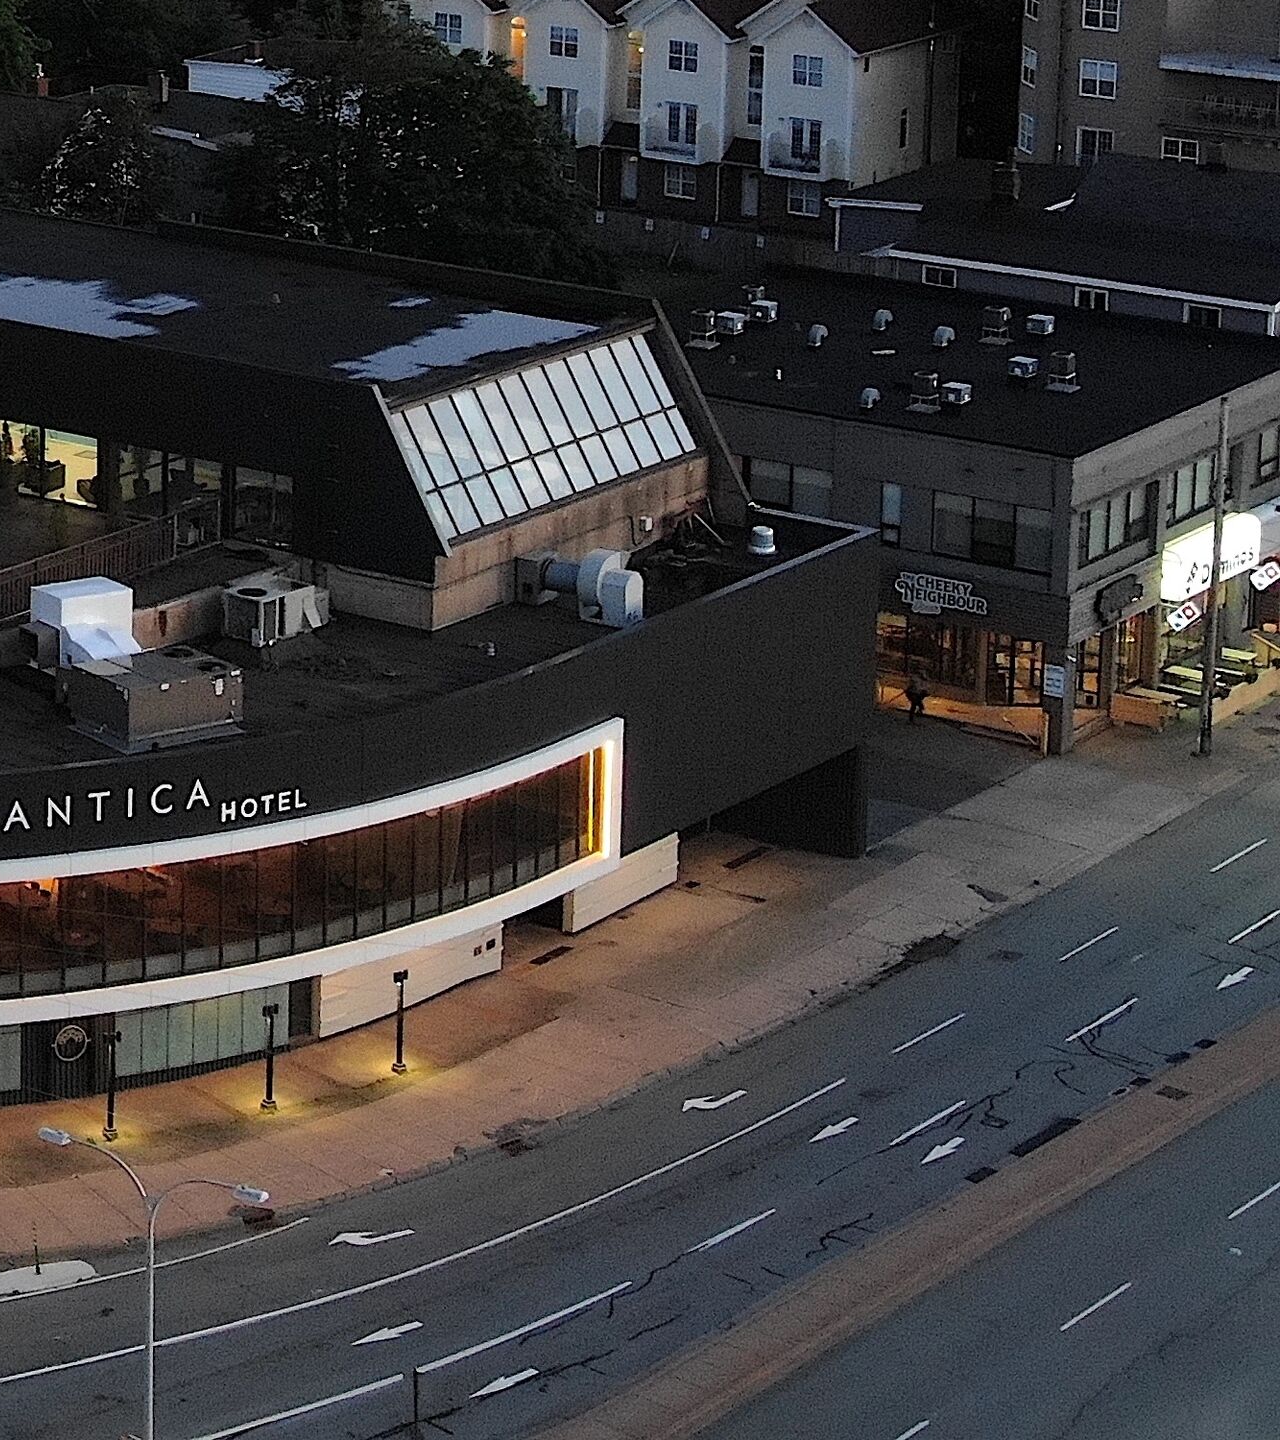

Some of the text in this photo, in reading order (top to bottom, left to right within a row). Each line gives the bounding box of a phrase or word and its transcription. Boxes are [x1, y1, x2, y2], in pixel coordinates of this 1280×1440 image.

[896, 580, 986, 613] NEIGHBOUR
[916, 575, 971, 597] CHEEKY
[220, 788, 308, 823] HOTEL
